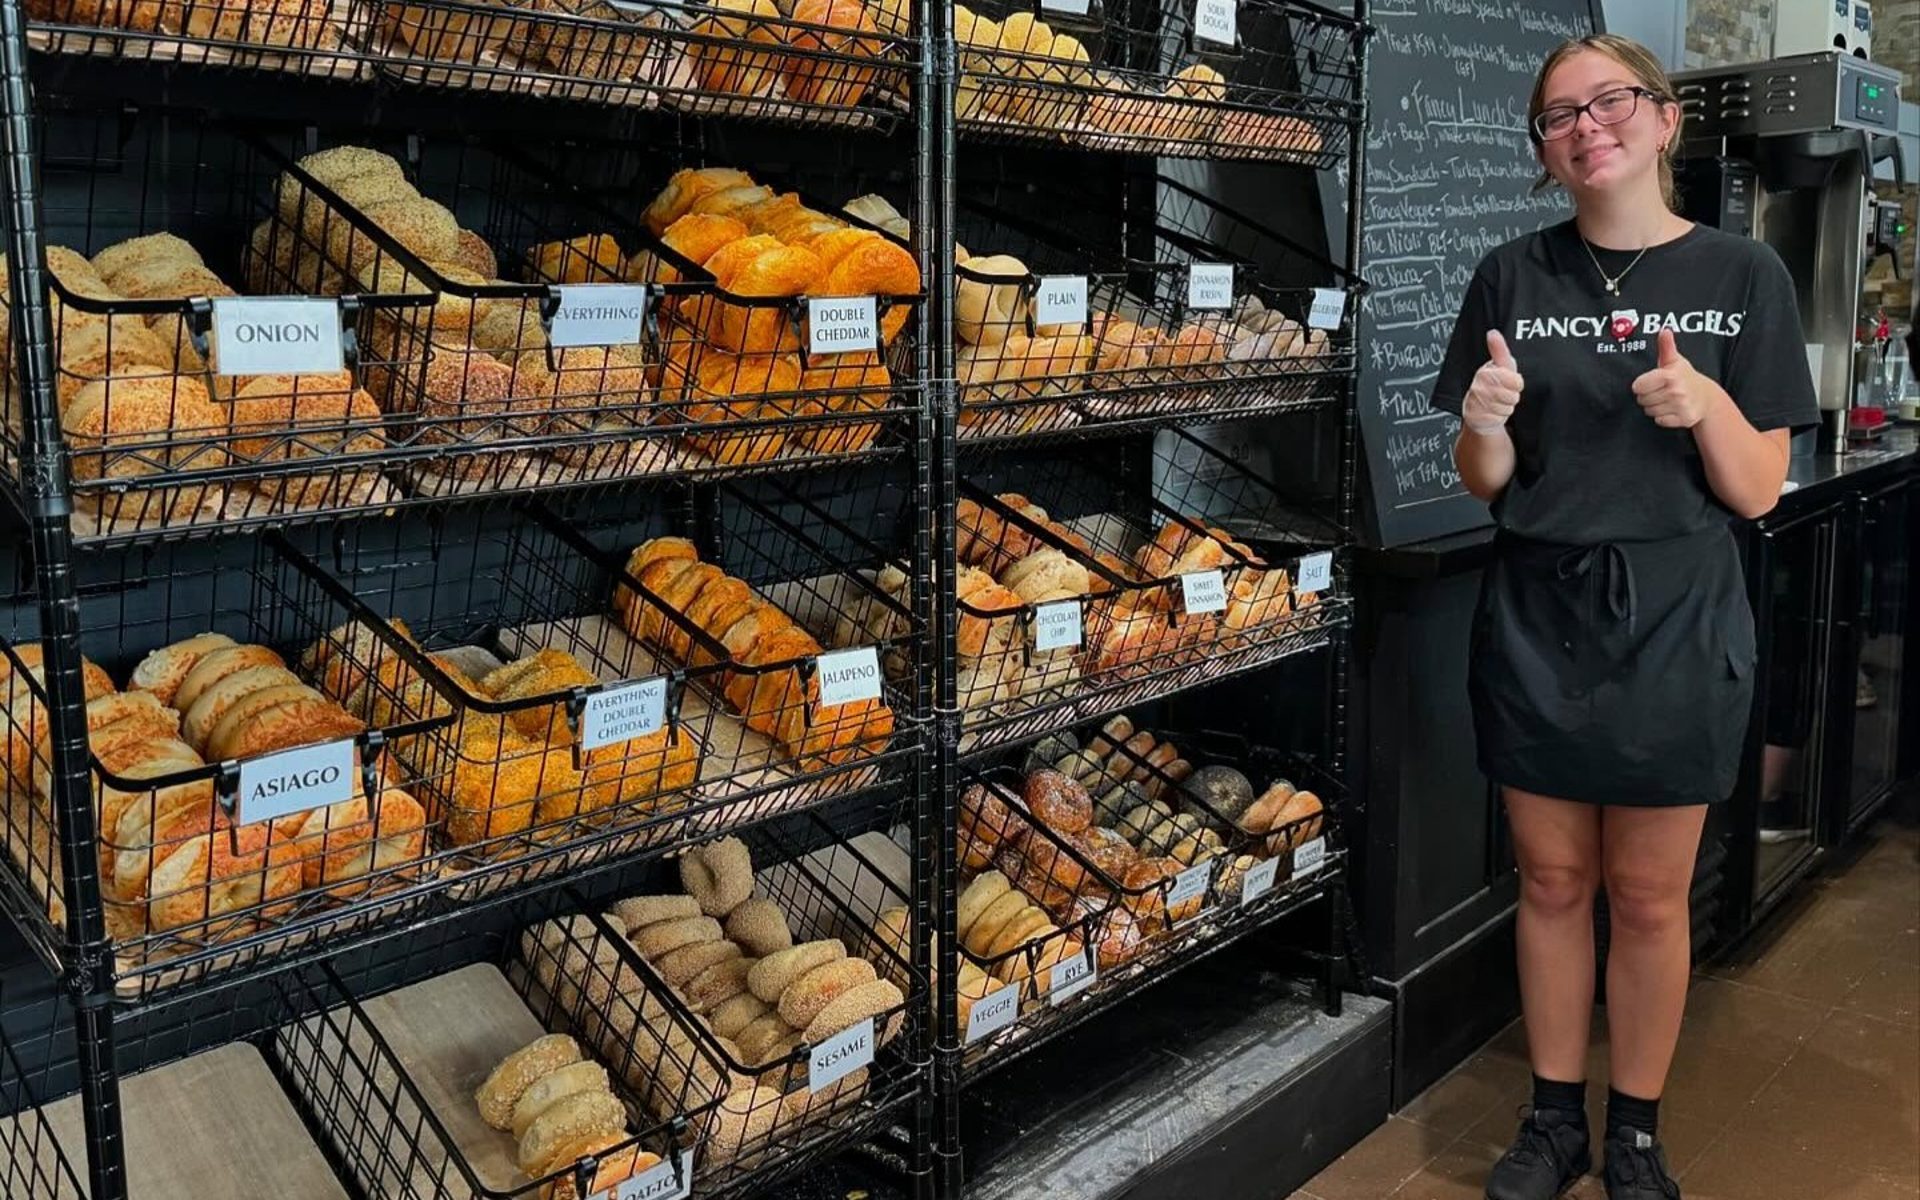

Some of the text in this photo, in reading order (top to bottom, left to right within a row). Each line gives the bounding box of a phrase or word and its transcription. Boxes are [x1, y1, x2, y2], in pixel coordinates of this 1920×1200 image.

[1048, 293, 1077, 306] PLAIN
[556, 307, 639, 322] EVERYTHING
[820, 308, 865, 323] DOUBLE
[235, 323, 320, 344] ONION
[816, 327, 870, 342] CHEDDAR
[1515, 316, 1608, 340] FANCY
[1597, 340, 1647, 353] Est. 1988
[1306, 566, 1323, 579] SALT
[1193, 580, 1214, 591] SWEET
[1038, 611, 1078, 626] CHOCOLATE
[1051, 627, 1066, 639] CHIP
[823, 664, 876, 689] JALAPENO
[592, 687, 658, 711] EVERYTHING
[603, 703, 646, 724] DOUBLE
[598, 717, 651, 740] CHEDDAR
[252, 765, 340, 801] ASIAGO
[1064, 961, 1085, 981] RYE
[974, 996, 1012, 1023] VEGGIE
[816, 1034, 868, 1072] SESAME
